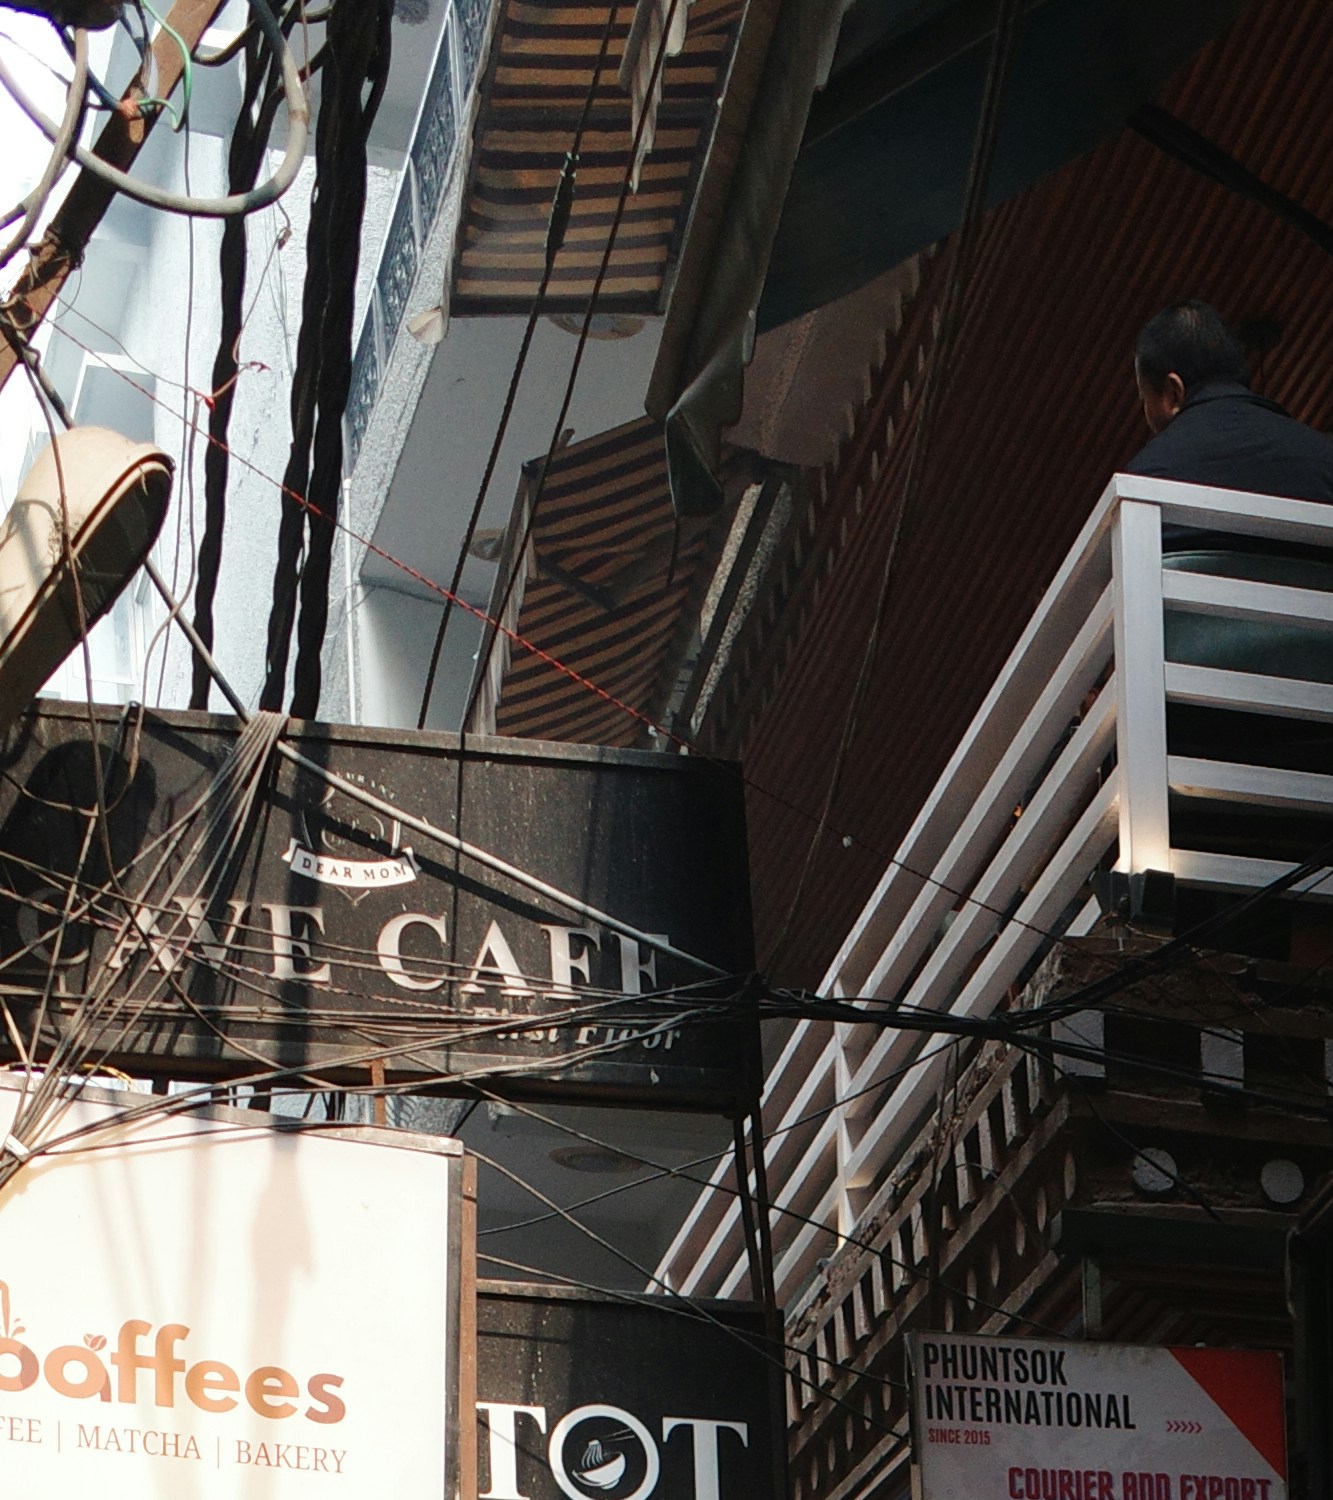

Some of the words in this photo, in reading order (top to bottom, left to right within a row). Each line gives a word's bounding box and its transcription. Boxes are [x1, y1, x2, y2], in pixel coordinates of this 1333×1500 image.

[302, 857, 353, 879] DEAR
[363, 864, 407, 880] MOM
[923, 1342, 1067, 1386] PHUNTSOK
[925, 1384, 1136, 1430] INTERNATIONAL
[76, 1423, 203, 1461] MATCHA
[235, 1439, 347, 1474] BAKERY
[929, 1427, 961, 1444] SINCE
[964, 1429, 991, 1446] 2015
